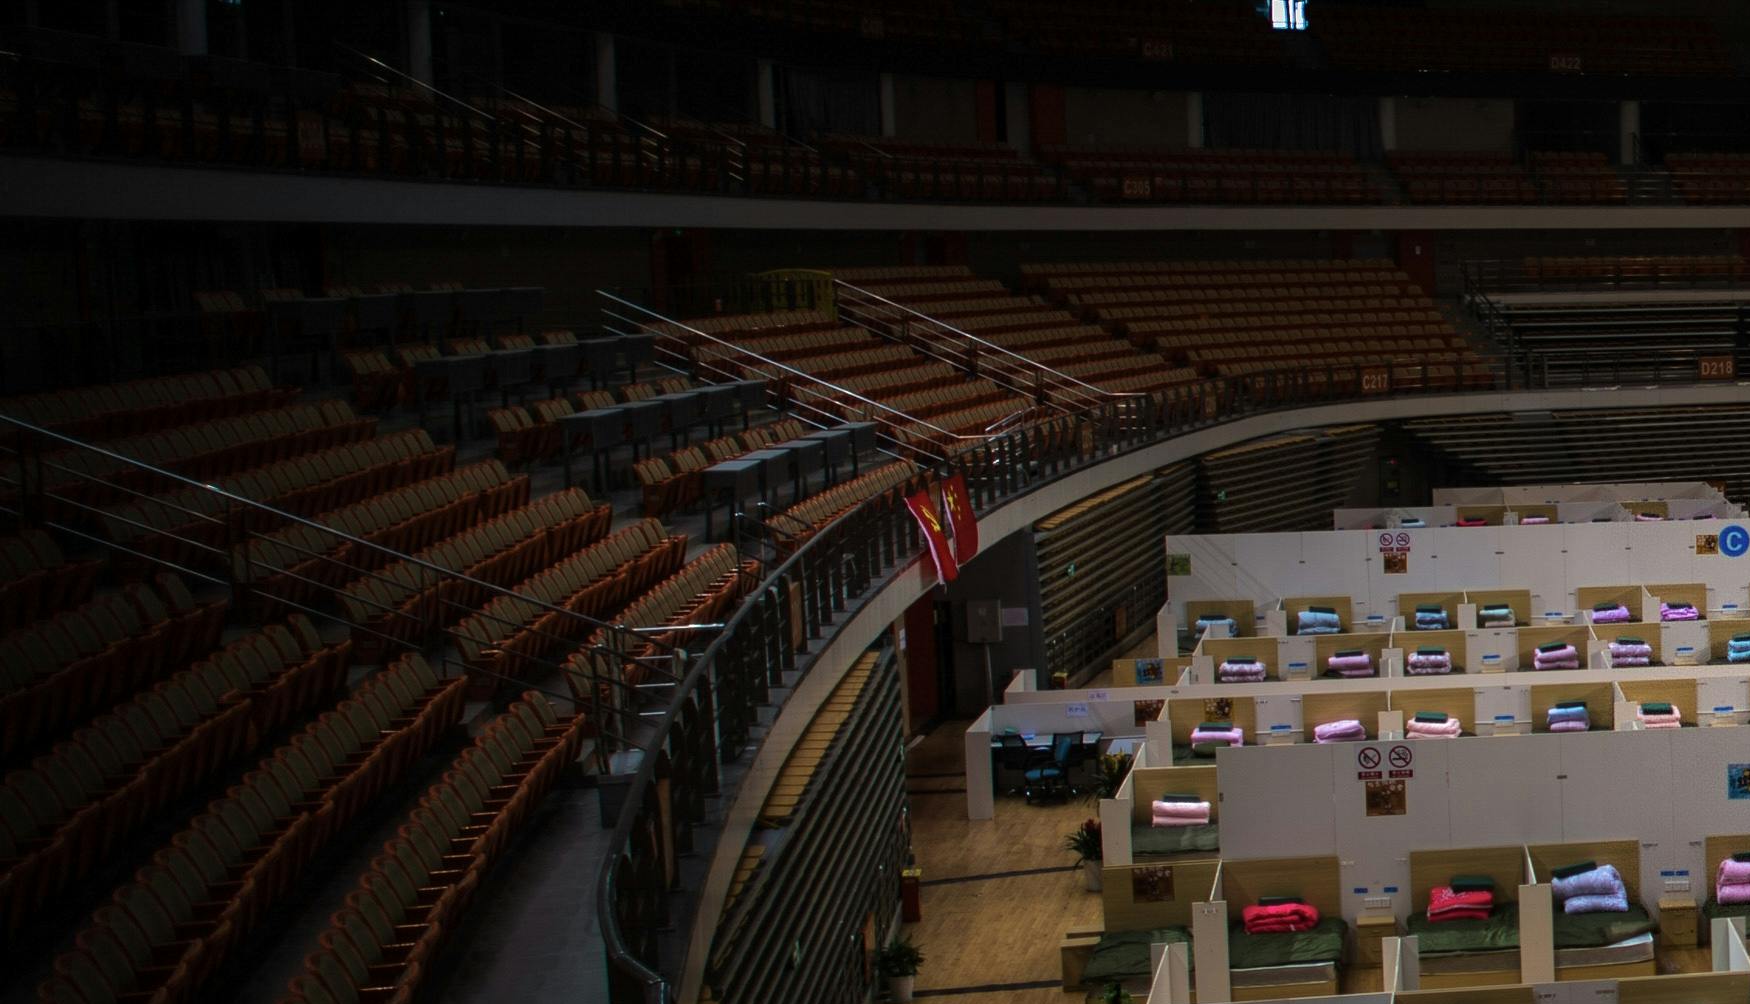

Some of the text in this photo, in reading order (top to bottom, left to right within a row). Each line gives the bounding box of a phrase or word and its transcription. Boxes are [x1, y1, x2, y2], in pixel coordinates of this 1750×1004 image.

[1701, 361, 1733, 376] D218
[1362, 373, 1388, 389] C217
[1726, 532, 1742, 551] C
